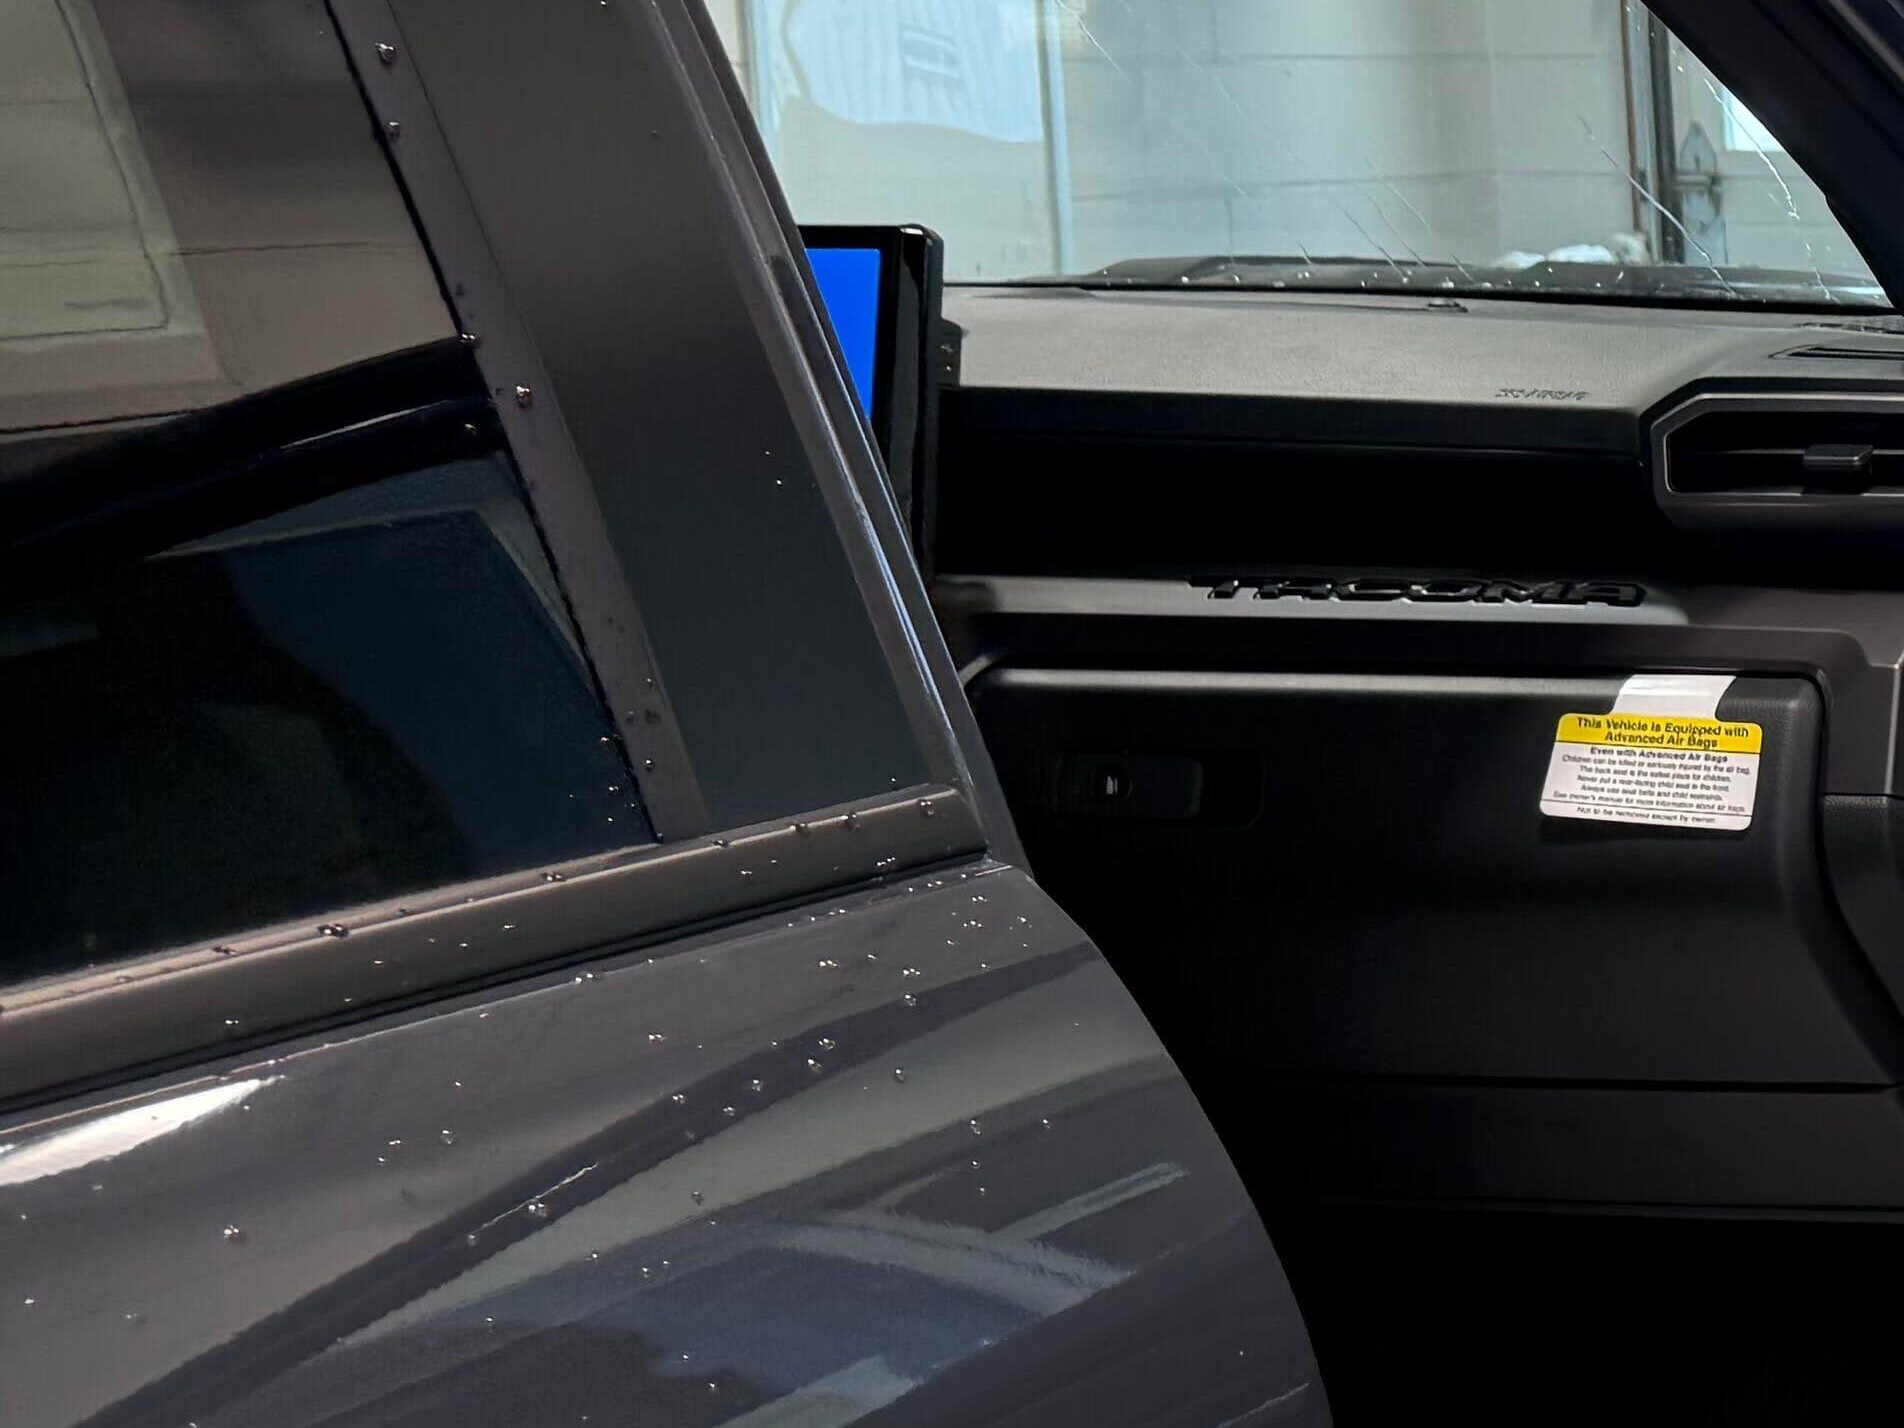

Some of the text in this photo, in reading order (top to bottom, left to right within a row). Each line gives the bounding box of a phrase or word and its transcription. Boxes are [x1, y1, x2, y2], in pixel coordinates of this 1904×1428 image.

[1577, 717, 1602, 729] This
[1606, 719, 1649, 732] Vehicle
[1665, 722, 1721, 737] Equipped
[1725, 727, 1749, 737] with
[1605, 732, 1718, 750] Advanced Air Bags
[1590, 747, 1728, 764] Even with Advanced Air Bags
